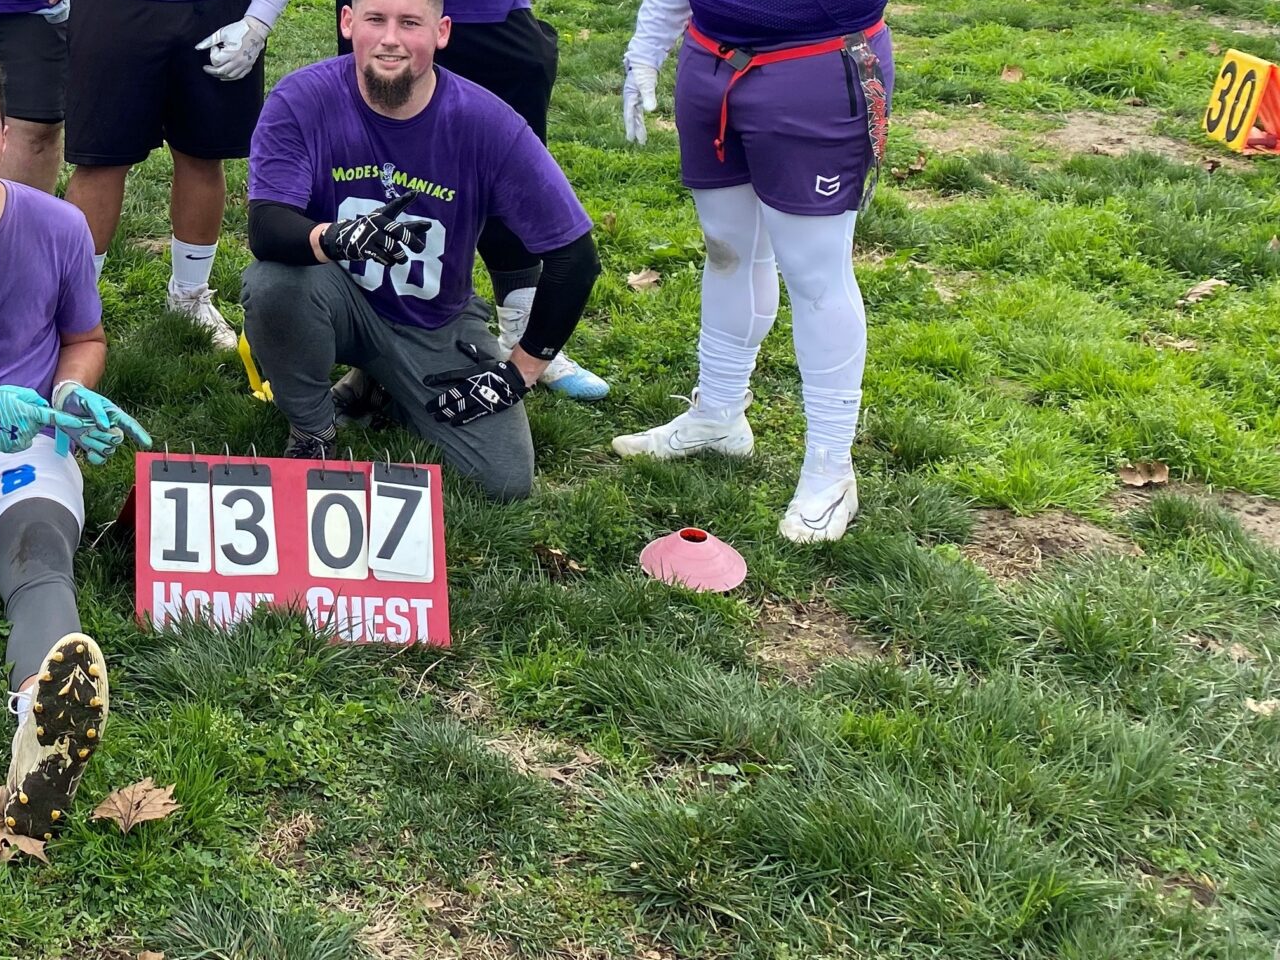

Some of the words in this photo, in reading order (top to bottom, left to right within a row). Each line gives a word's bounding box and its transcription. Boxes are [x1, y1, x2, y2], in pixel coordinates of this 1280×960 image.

[1206, 60, 1257, 143] 30
[332, 165, 380, 182] MODES
[393, 170, 456, 202] MANIACS
[306, 586, 433, 644] GUEST
